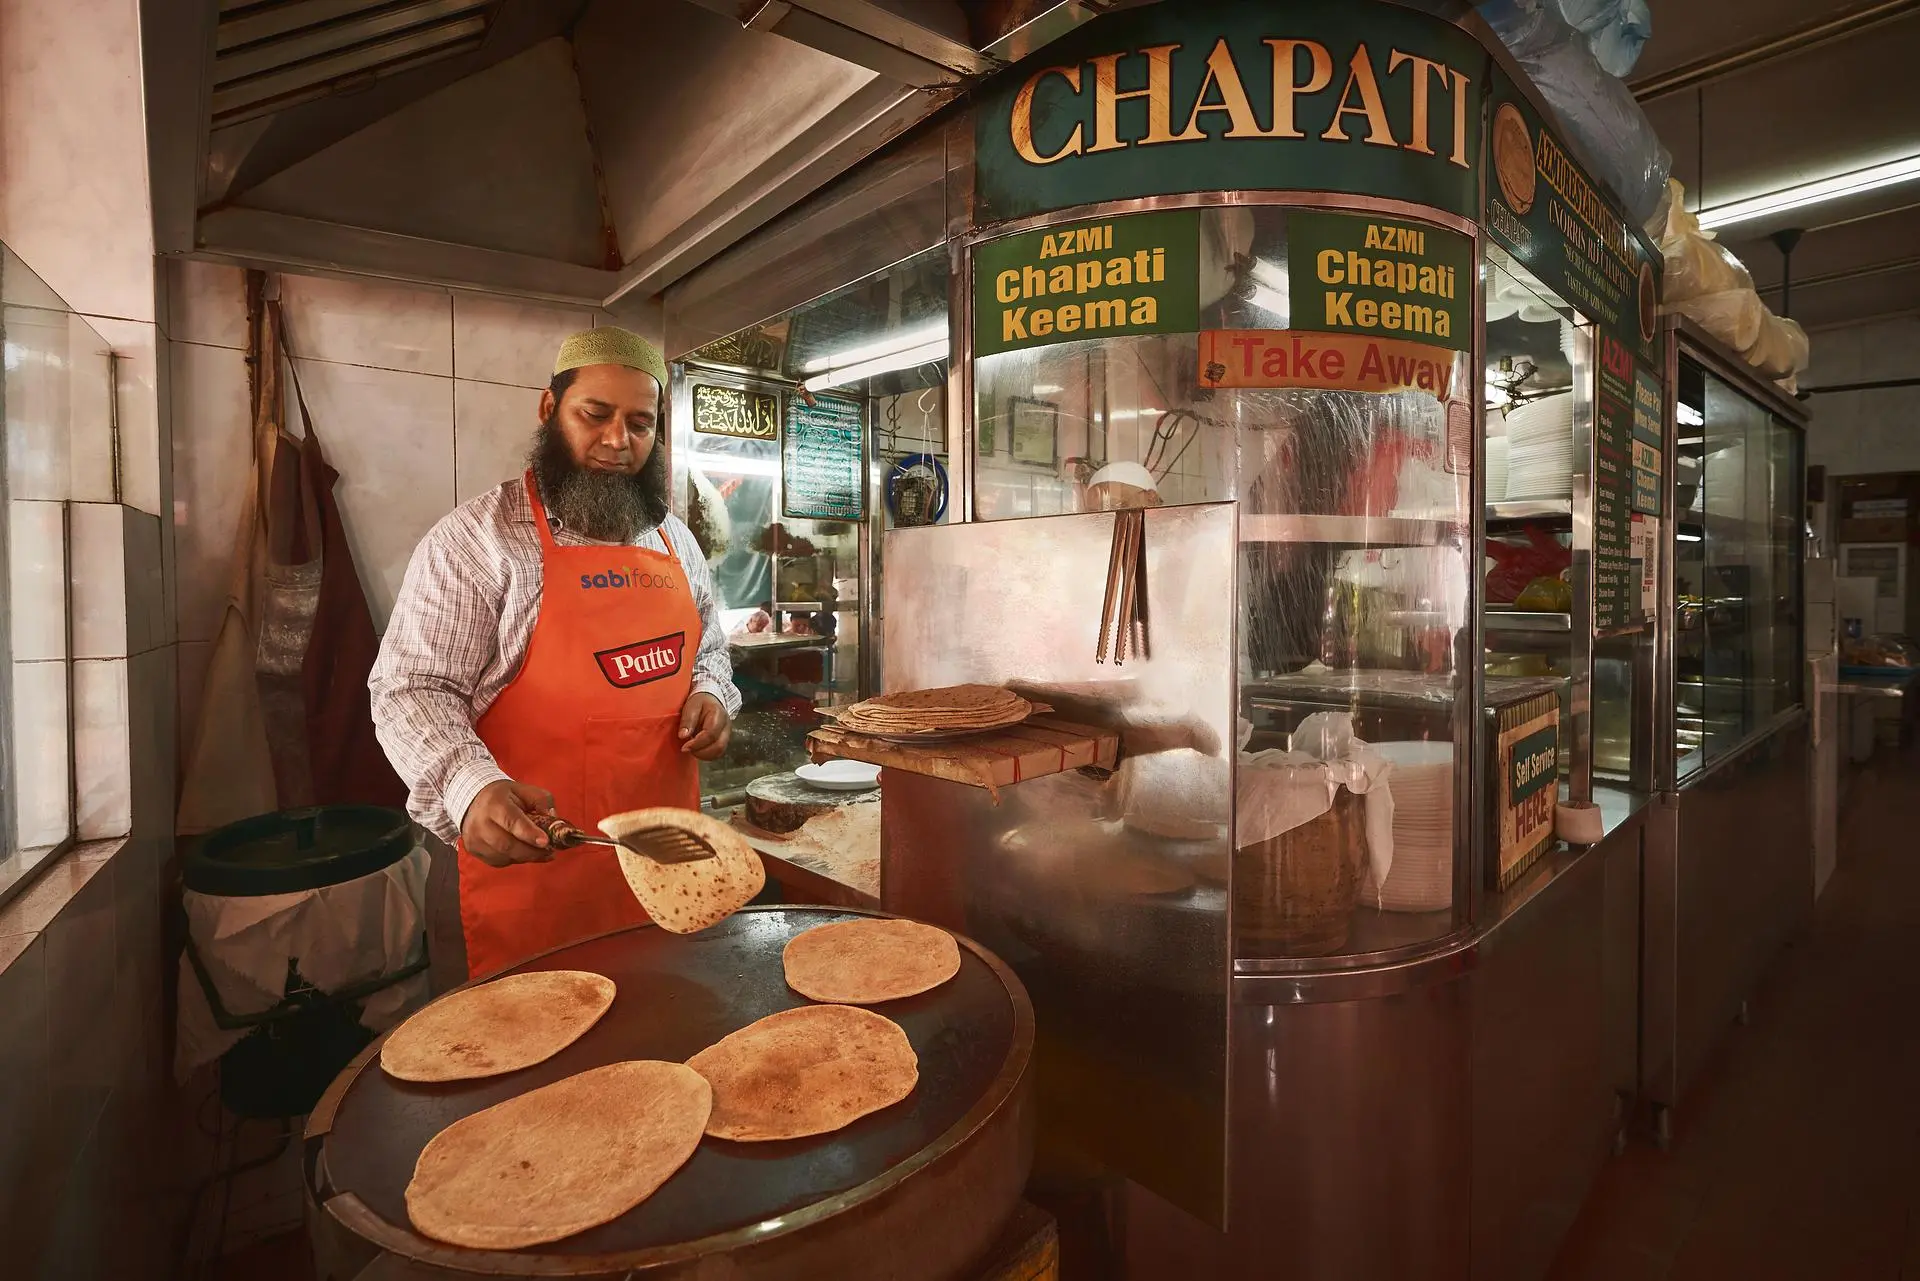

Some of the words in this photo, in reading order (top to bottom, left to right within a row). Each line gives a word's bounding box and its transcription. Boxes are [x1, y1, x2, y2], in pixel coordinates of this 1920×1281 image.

[1010, 37, 1471, 169] CHAPATI
[1039, 225, 1113, 260] AZMI
[1364, 225, 1425, 256] AZMI
[996, 248, 1166, 304] Chapati
[1316, 250, 1455, 300] Chapati
[1002, 296, 1158, 342] Keema
[1325, 292, 1451, 338] Keema
[1232, 338, 1346, 379] Take
[1357, 344, 1453, 396] Away
[1602, 335, 1633, 385] AZMI
[1531, 746, 1555, 779] Service
[1516, 785, 1550, 844] HERE
